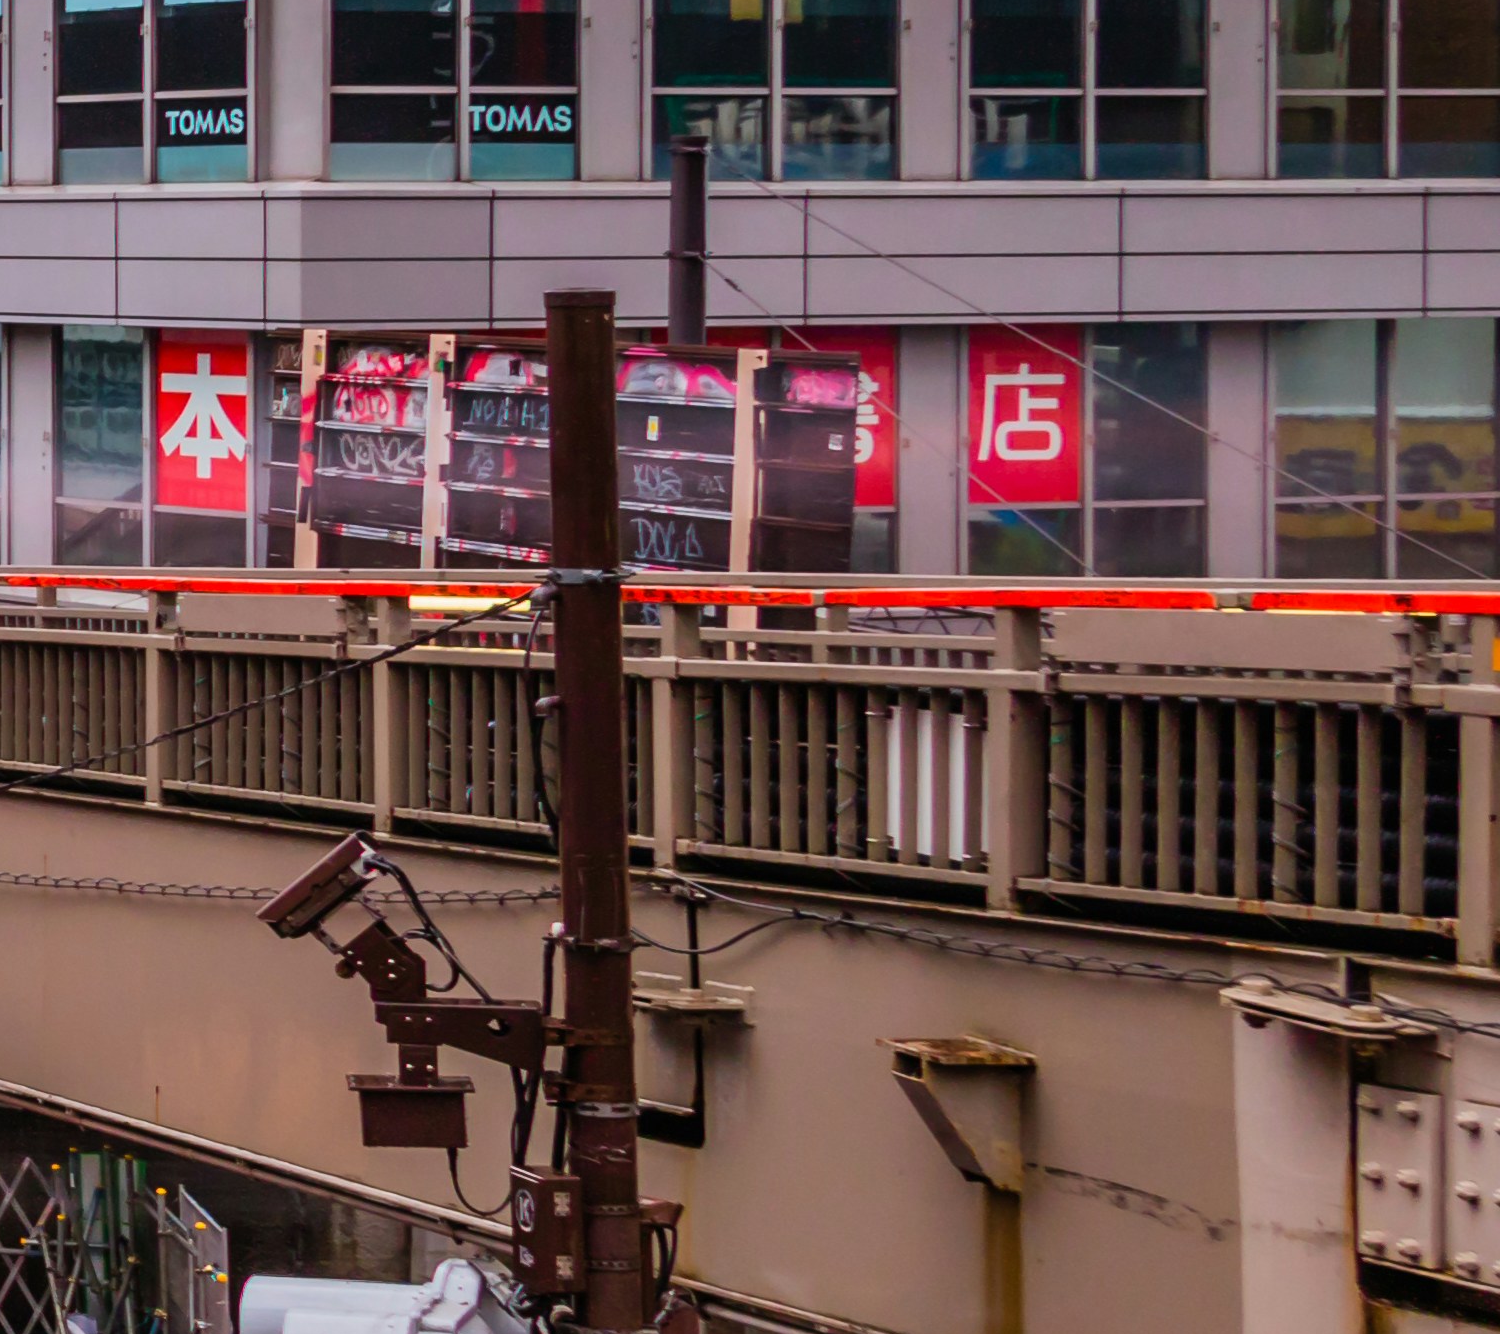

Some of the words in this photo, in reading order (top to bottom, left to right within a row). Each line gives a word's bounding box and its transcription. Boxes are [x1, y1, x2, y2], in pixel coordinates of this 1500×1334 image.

[166, 108, 244, 136] TOMAS
[470, 104, 573, 132] TOMAS
[160, 352, 247, 479] 本
[978, 363, 1066, 463] 店
